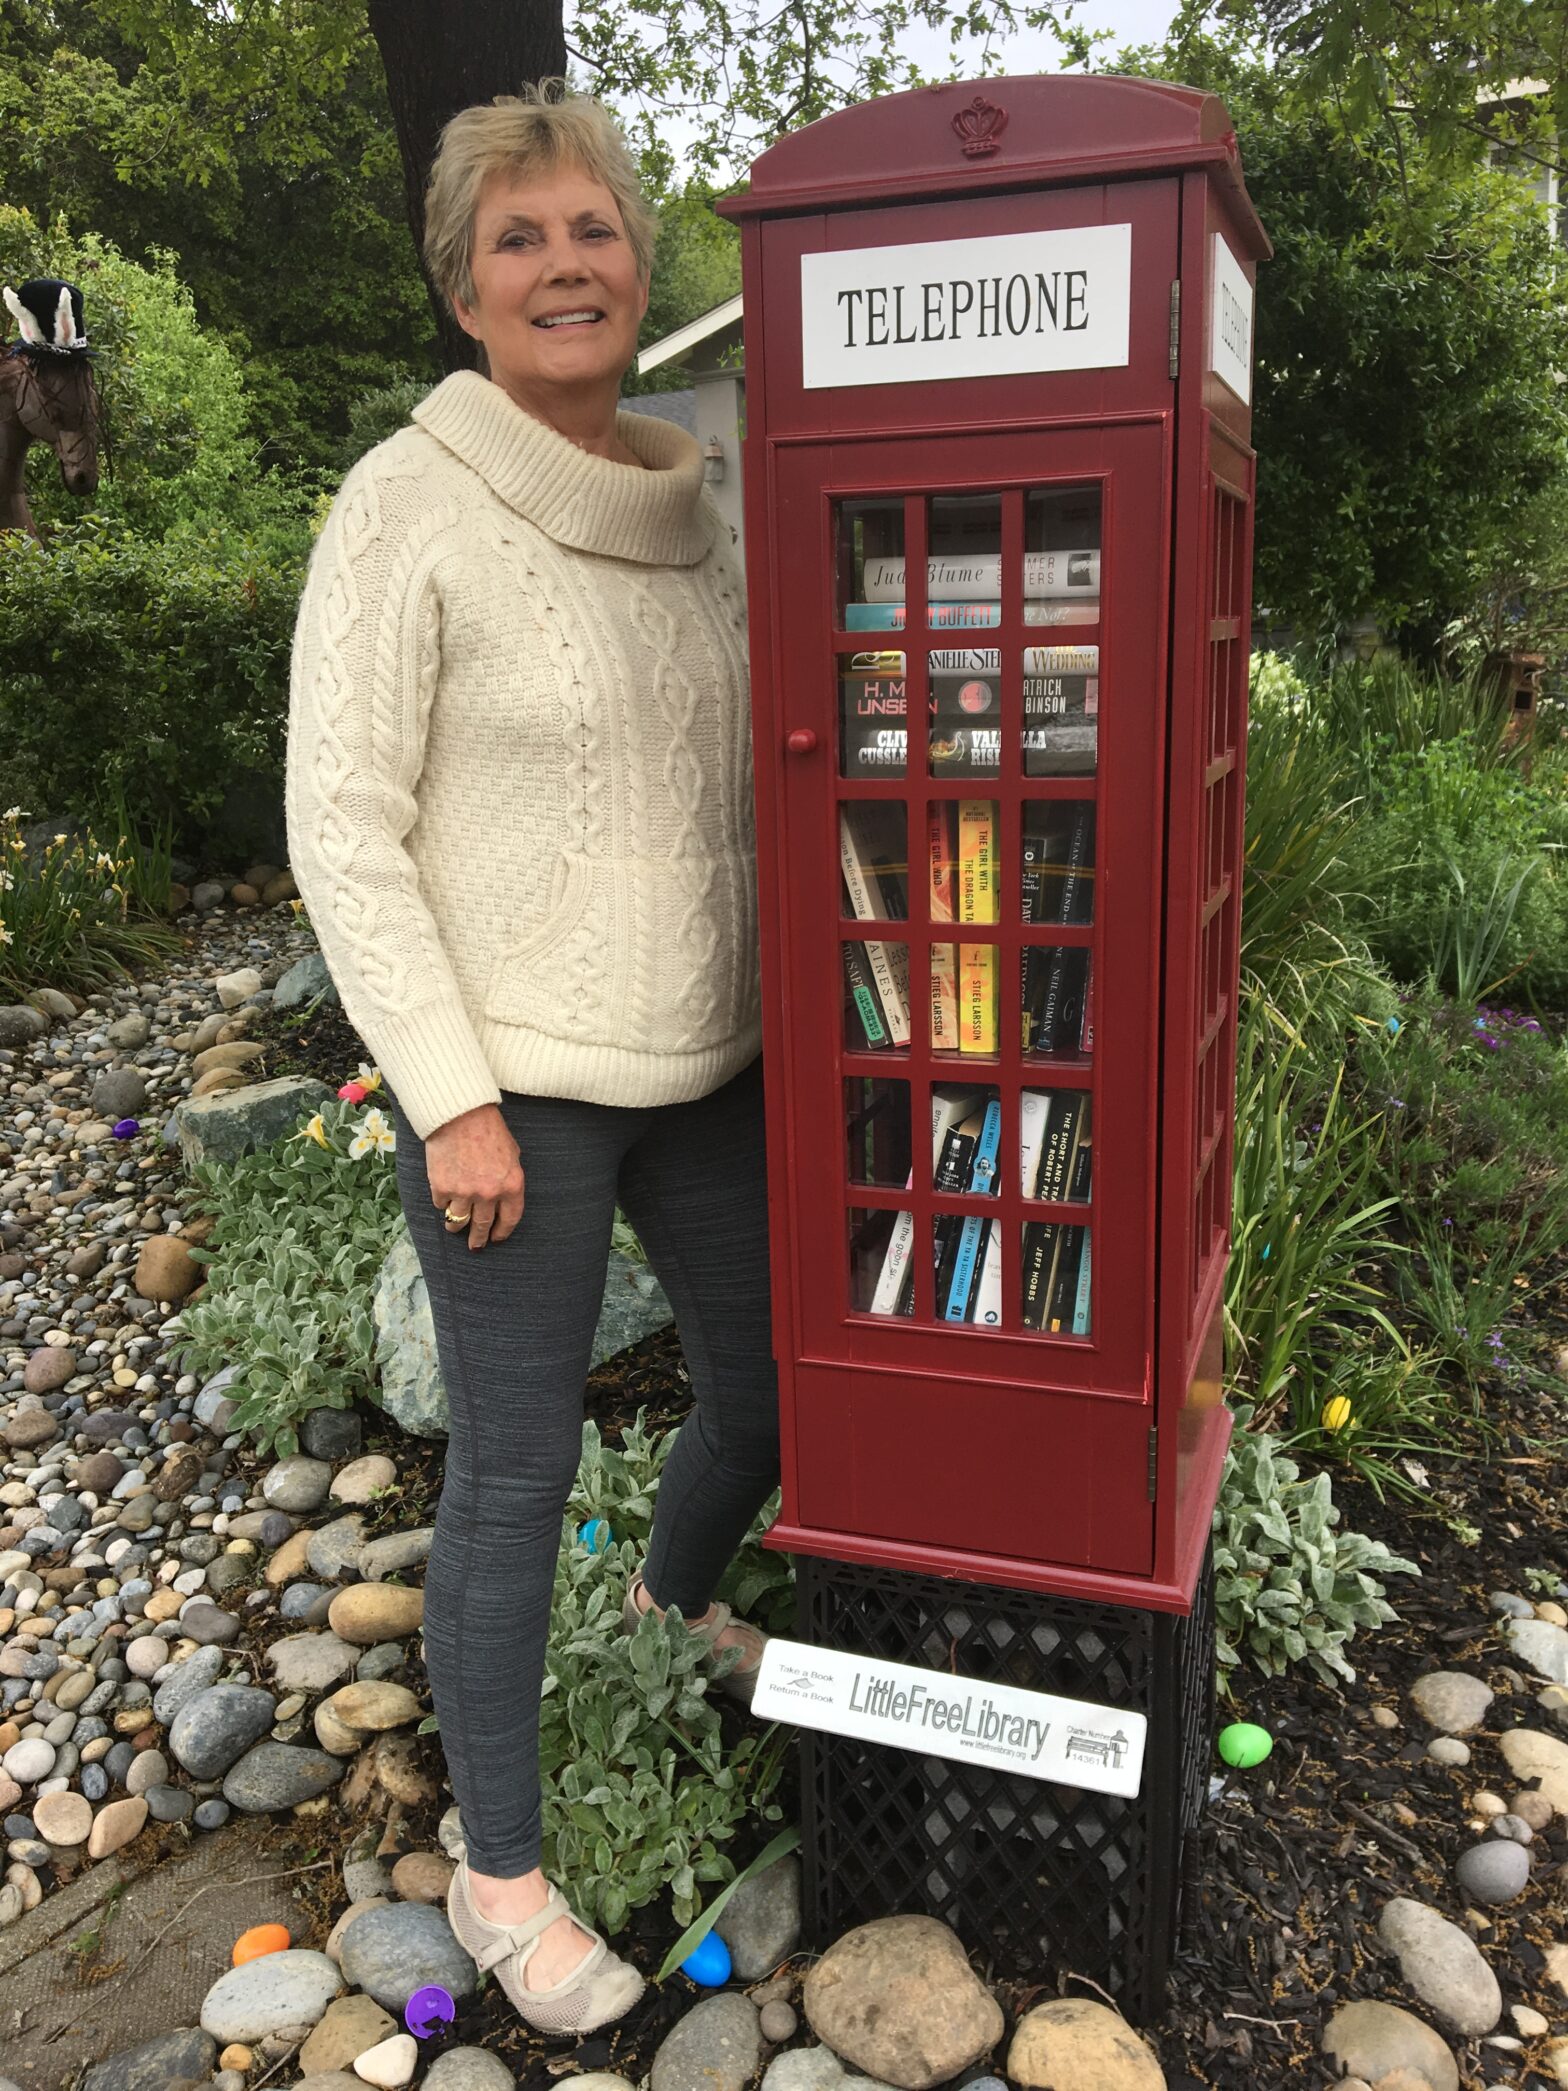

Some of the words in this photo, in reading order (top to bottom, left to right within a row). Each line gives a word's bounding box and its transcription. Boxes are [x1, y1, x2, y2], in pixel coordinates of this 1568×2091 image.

[838, 270, 1089, 348] TELEPHONE
[874, 565, 906, 587] Jud
[927, 563, 984, 584] Blume
[939, 605, 992, 626] BUFFETT
[928, 650, 969, 670] ANIELLE
[1033, 650, 1095, 673] WEDDING
[1022, 679, 1062, 697] ATRICK
[1025, 696, 1067, 714] BINSON
[877, 730, 907, 748] CLIV
[858, 748, 907, 766] CUSSLE
[931, 828, 940, 843] THE
[979, 830, 988, 846] THE
[1071, 828, 1082, 860] OCEAN
[932, 846, 941, 865] GIRL
[978, 848, 988, 868] GIRL
[933, 868, 943, 886] WHO
[965, 859, 974, 874] THE
[845, 857, 858, 886] Before
[854, 888, 867, 916] Dying
[978, 870, 988, 891] WITH
[1067, 872, 1076, 891] THE
[964, 877, 974, 911] DRAGON
[1063, 893, 1073, 912] END
[1021, 898, 1033, 924] DAV
[870, 944, 893, 997] AINES
[1049, 968, 1061, 991] NEIL
[932, 976, 942, 999] STIEG
[972, 980, 982, 1003] STIEG
[933, 1001, 943, 1036] LARSSON
[972, 1005, 981, 1041] LARSSON
[1043, 993, 1056, 1033] GAIMAN
[990, 1106, 999, 1130] REBECCA
[1062, 1112, 1073, 1129] THE
[985, 1131, 996, 1150] WELLS
[1050, 1133, 1059, 1147] OF
[1058, 1132, 1069, 1162] SHORT
[1043, 1149, 1055, 1184] ROBERT
[1054, 1163, 1063, 1183] AND
[1040, 1185, 1050, 1201] PEA
[900, 1227, 910, 1242] the
[1043, 1225, 1053, 1239] IFE
[893, 1243, 904, 1266] goon
[1032, 1247, 1044, 1269] JEFF
[956, 1263, 969, 1297] SISTERHOOD
[1027, 1271, 1039, 1302] HOBBS
[1079, 1273, 1089, 1303] STREET
[779, 1663, 800, 1676] Take
[811, 1671, 834, 1683] Book
[769, 1683, 800, 1697] Return
[810, 1692, 834, 1704] Book
[849, 1673, 1050, 1761] LittleFreeLibrary
[1073, 1752, 1100, 1766] 14361
